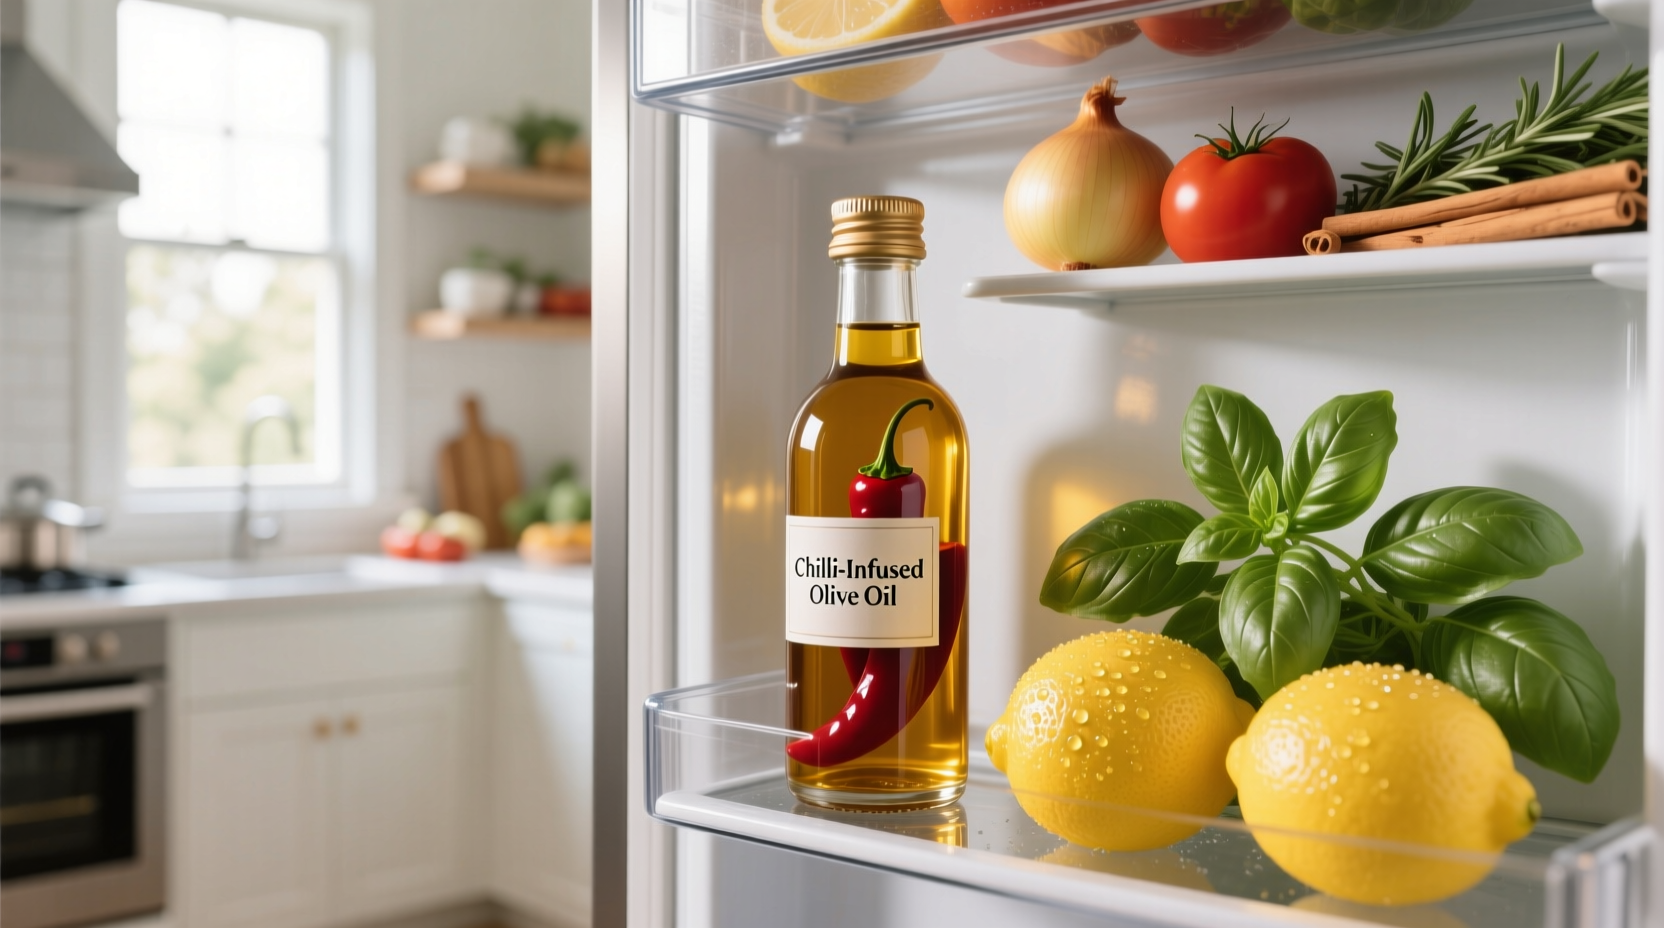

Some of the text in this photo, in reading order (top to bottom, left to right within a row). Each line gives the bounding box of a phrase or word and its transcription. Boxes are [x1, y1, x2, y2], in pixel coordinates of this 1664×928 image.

[794, 556, 924, 579] Chilli-Infused
[809, 584, 897, 606] Olive Oil
